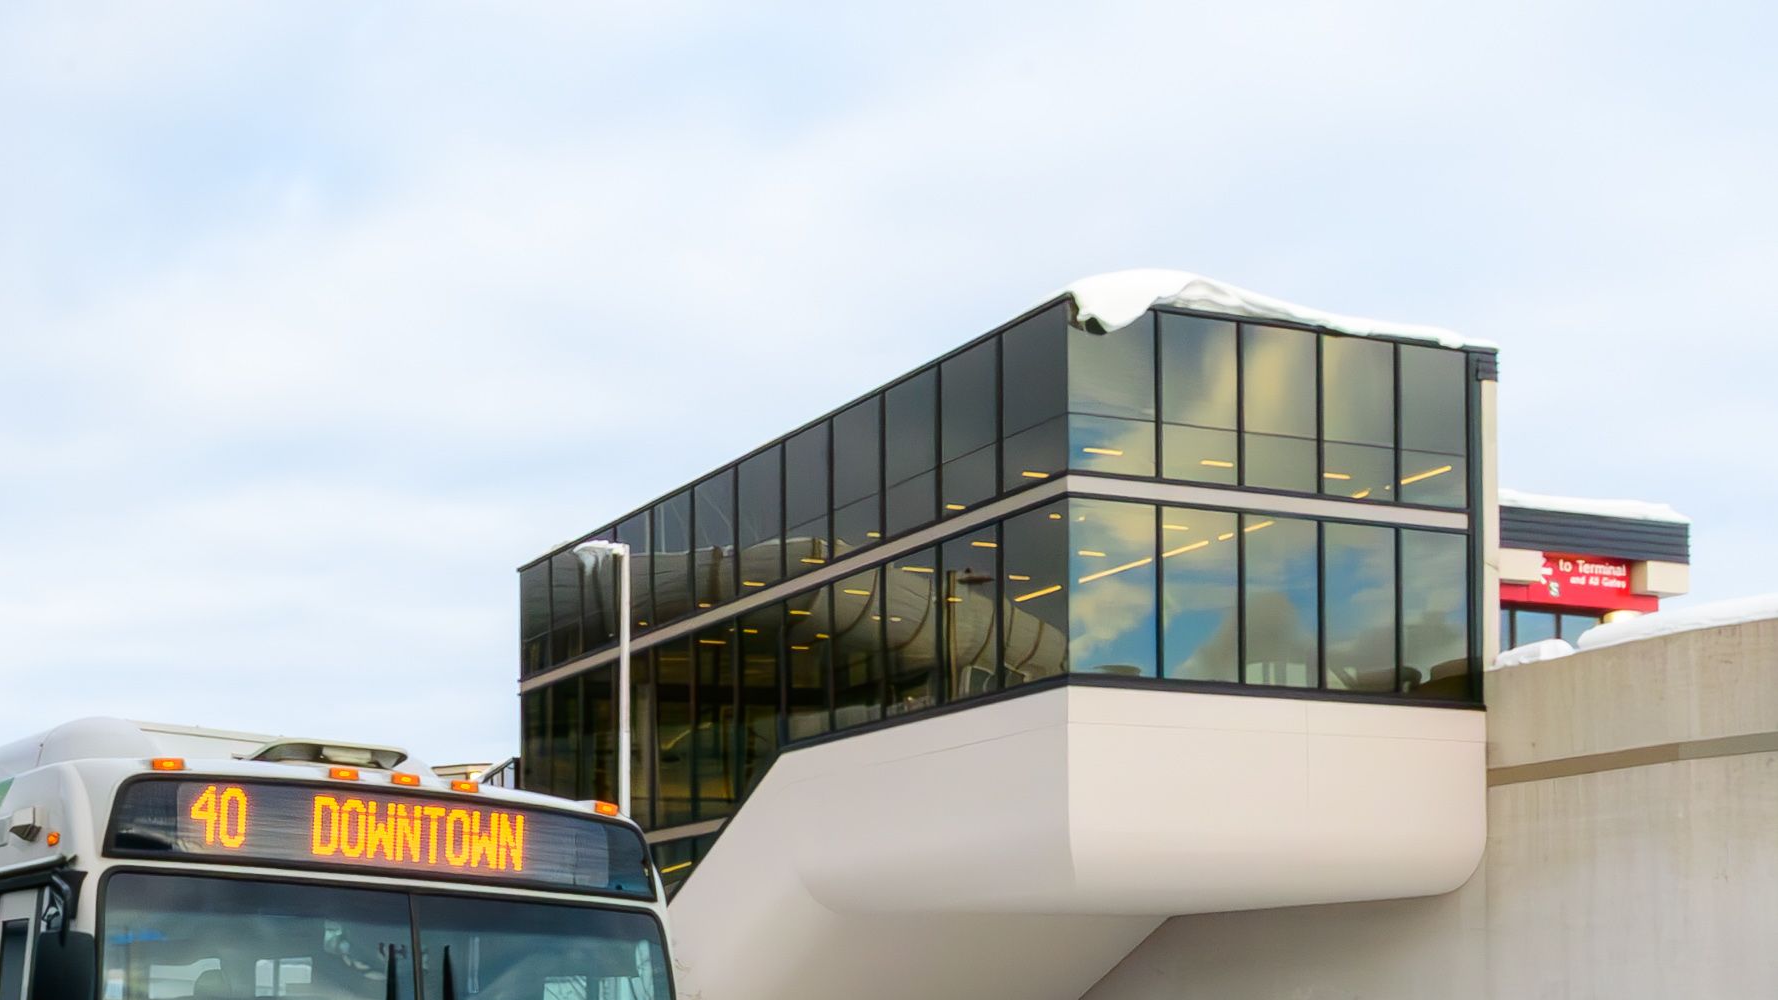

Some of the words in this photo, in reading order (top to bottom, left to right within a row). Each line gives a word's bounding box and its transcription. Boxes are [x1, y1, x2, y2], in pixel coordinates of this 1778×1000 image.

[1559, 559, 1573, 572] to
[1576, 560, 1627, 576] Terminal
[190, 784, 248, 849] 40
[311, 794, 526, 873] DOWNTOWN
